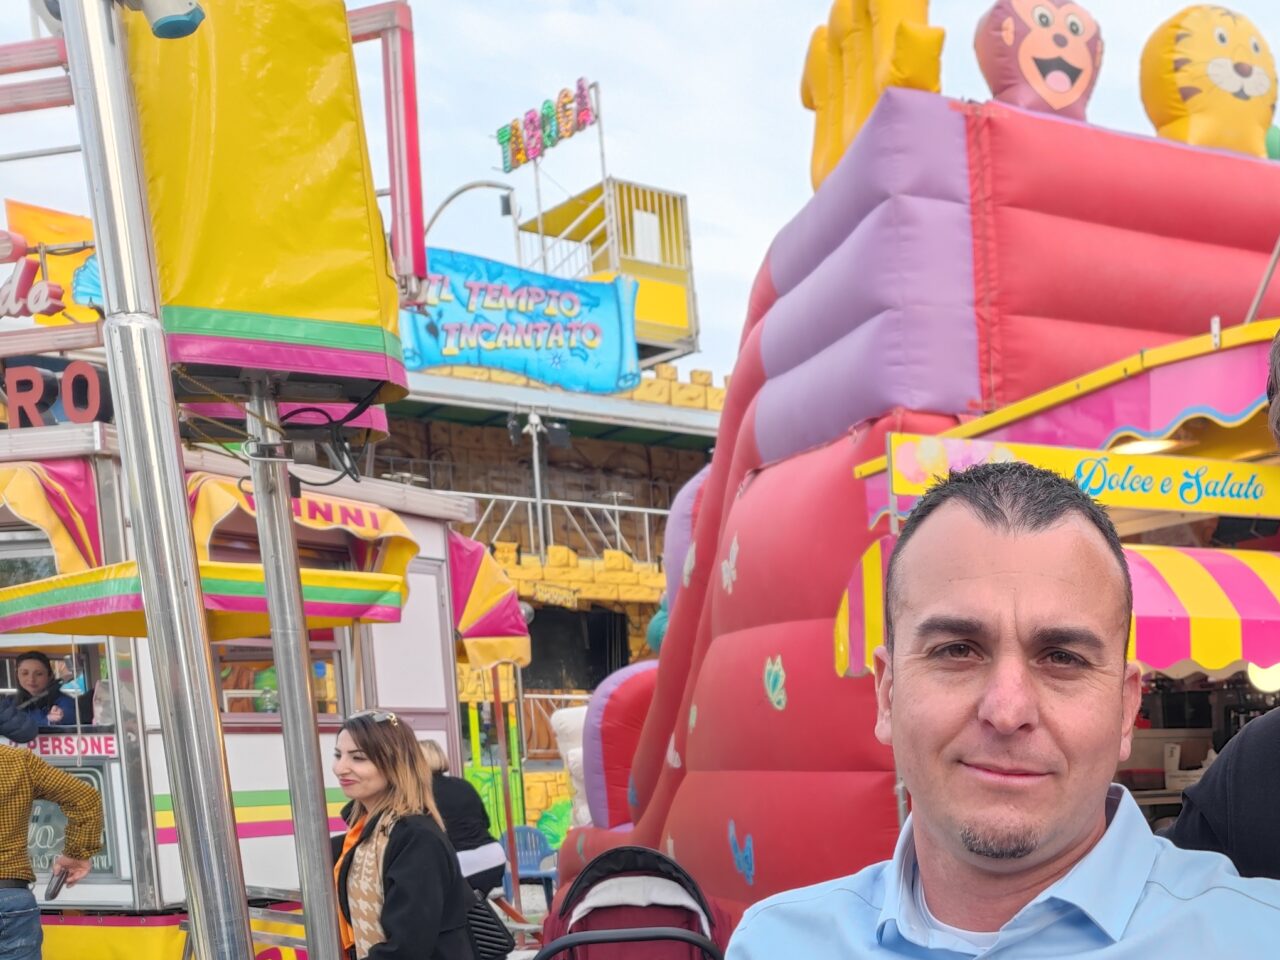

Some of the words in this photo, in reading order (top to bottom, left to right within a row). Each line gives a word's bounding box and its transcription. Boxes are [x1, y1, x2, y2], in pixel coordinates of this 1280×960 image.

[465, 280, 582, 319] TEMPIO
[440, 322, 603, 357] INCANTATO
[1075, 457, 1154, 497] Dolce
[1160, 476, 1173, 494] e
[1179, 465, 1265, 505] Salato
